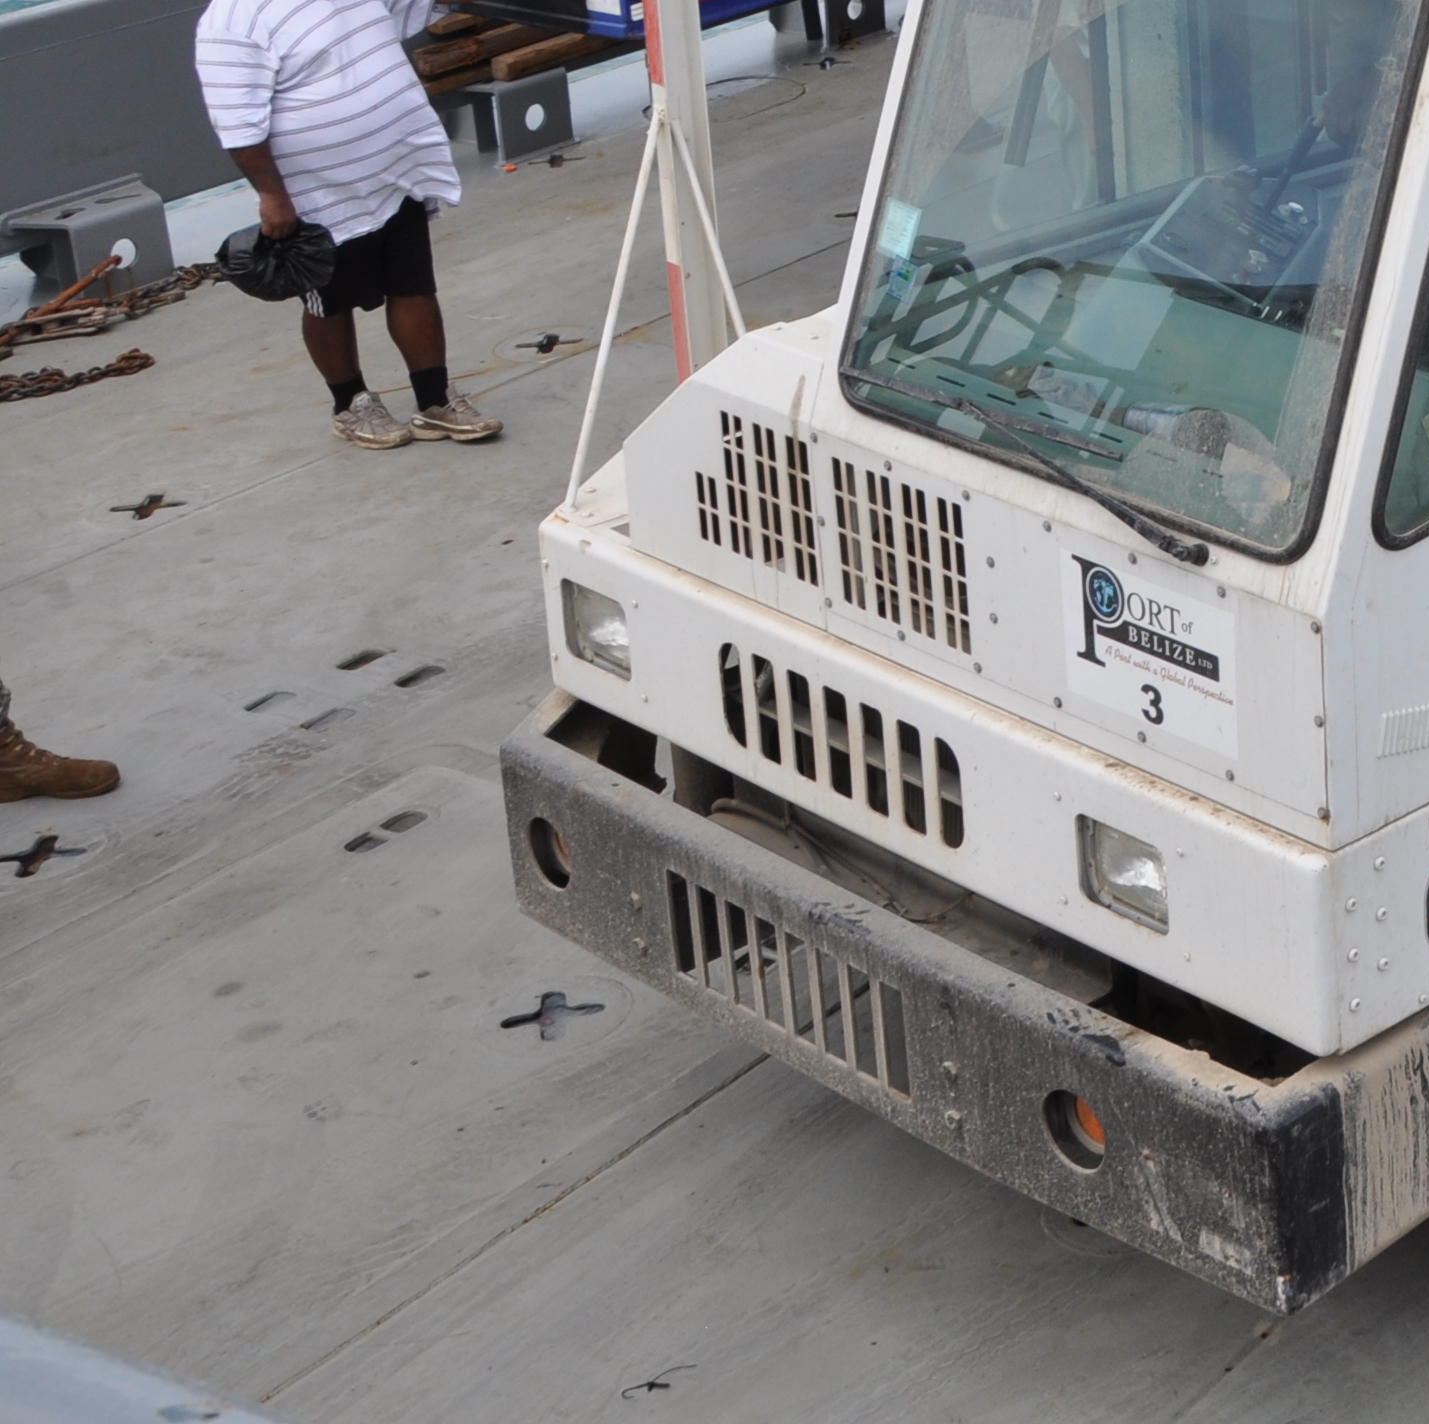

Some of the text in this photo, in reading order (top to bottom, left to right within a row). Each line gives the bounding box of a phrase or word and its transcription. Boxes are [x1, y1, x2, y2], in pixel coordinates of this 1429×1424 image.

[1071, 553, 1194, 668] PORT of
[1128, 626, 1213, 670] BELIZE LTD
[1141, 683, 1164, 726] 3
